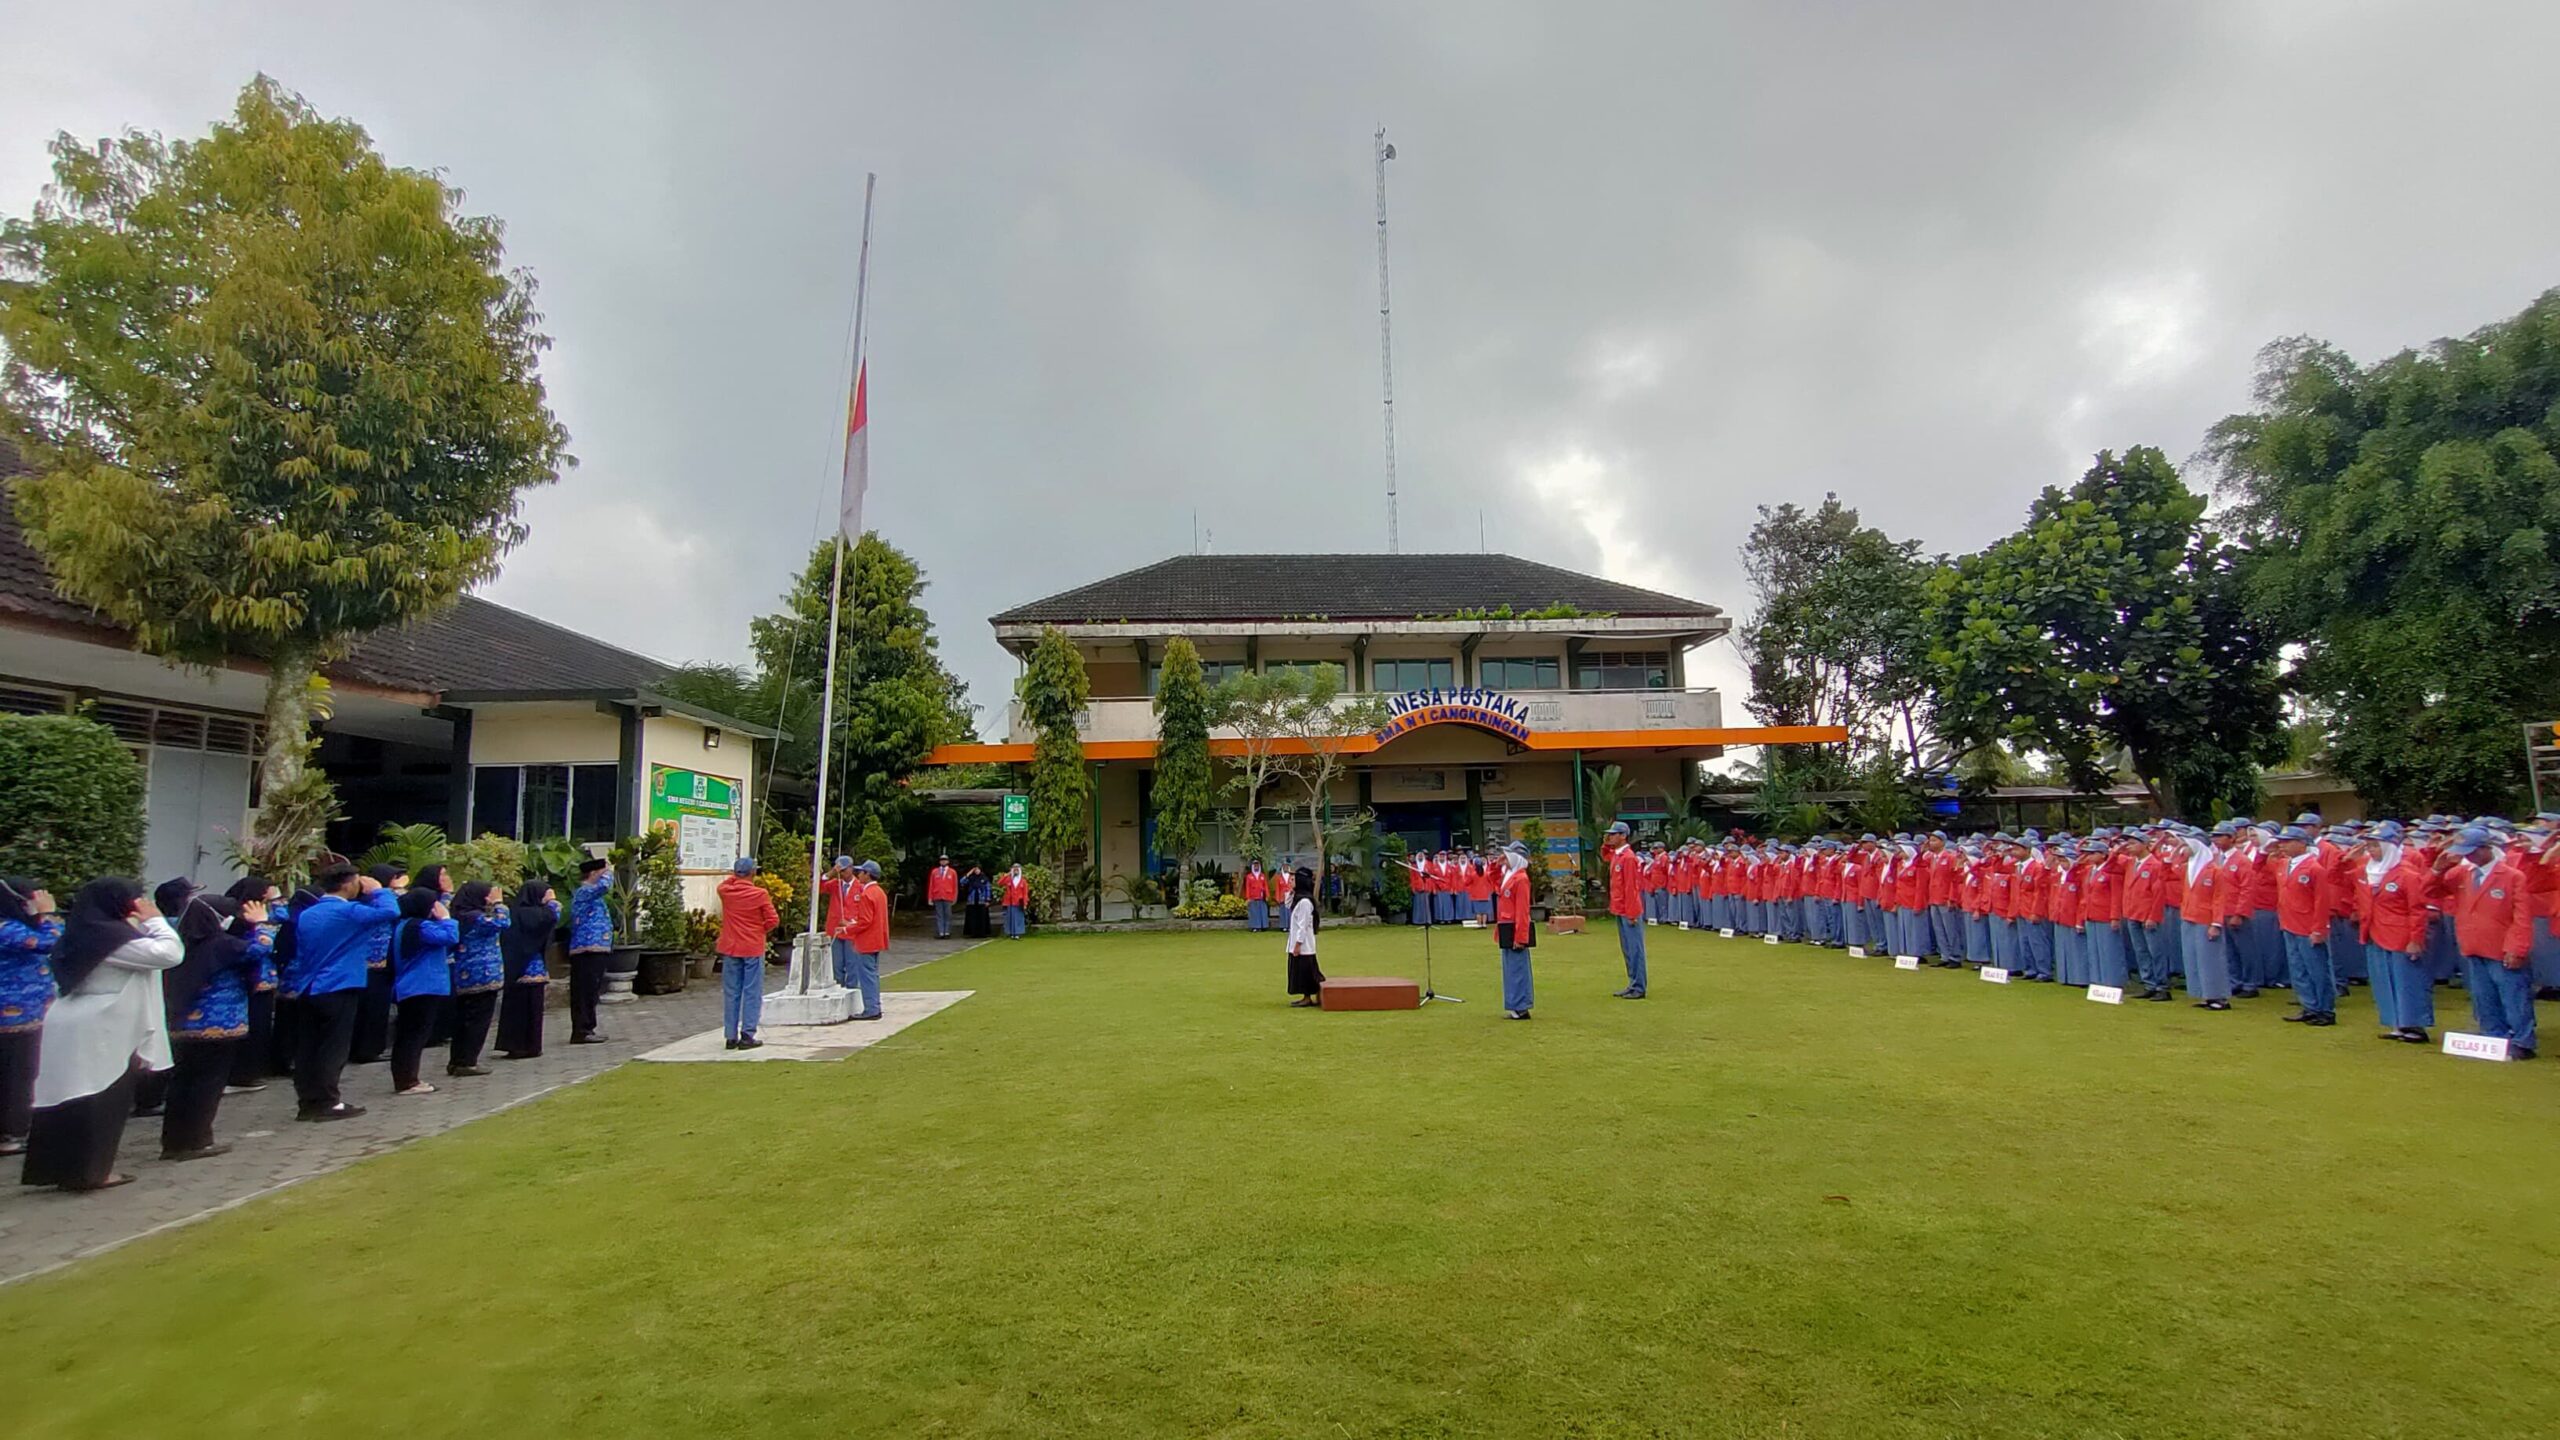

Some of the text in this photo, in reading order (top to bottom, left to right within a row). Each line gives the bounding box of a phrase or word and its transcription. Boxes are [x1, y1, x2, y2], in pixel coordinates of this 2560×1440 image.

[1382, 687, 1530, 725] ANESA PUSTAKA
[1376, 722, 1405, 745] SMA
[1405, 715, 1417, 729] N
[1429, 708, 1531, 742] CANGKRINGAN
[2450, 1039, 2480, 1052] KELAS
